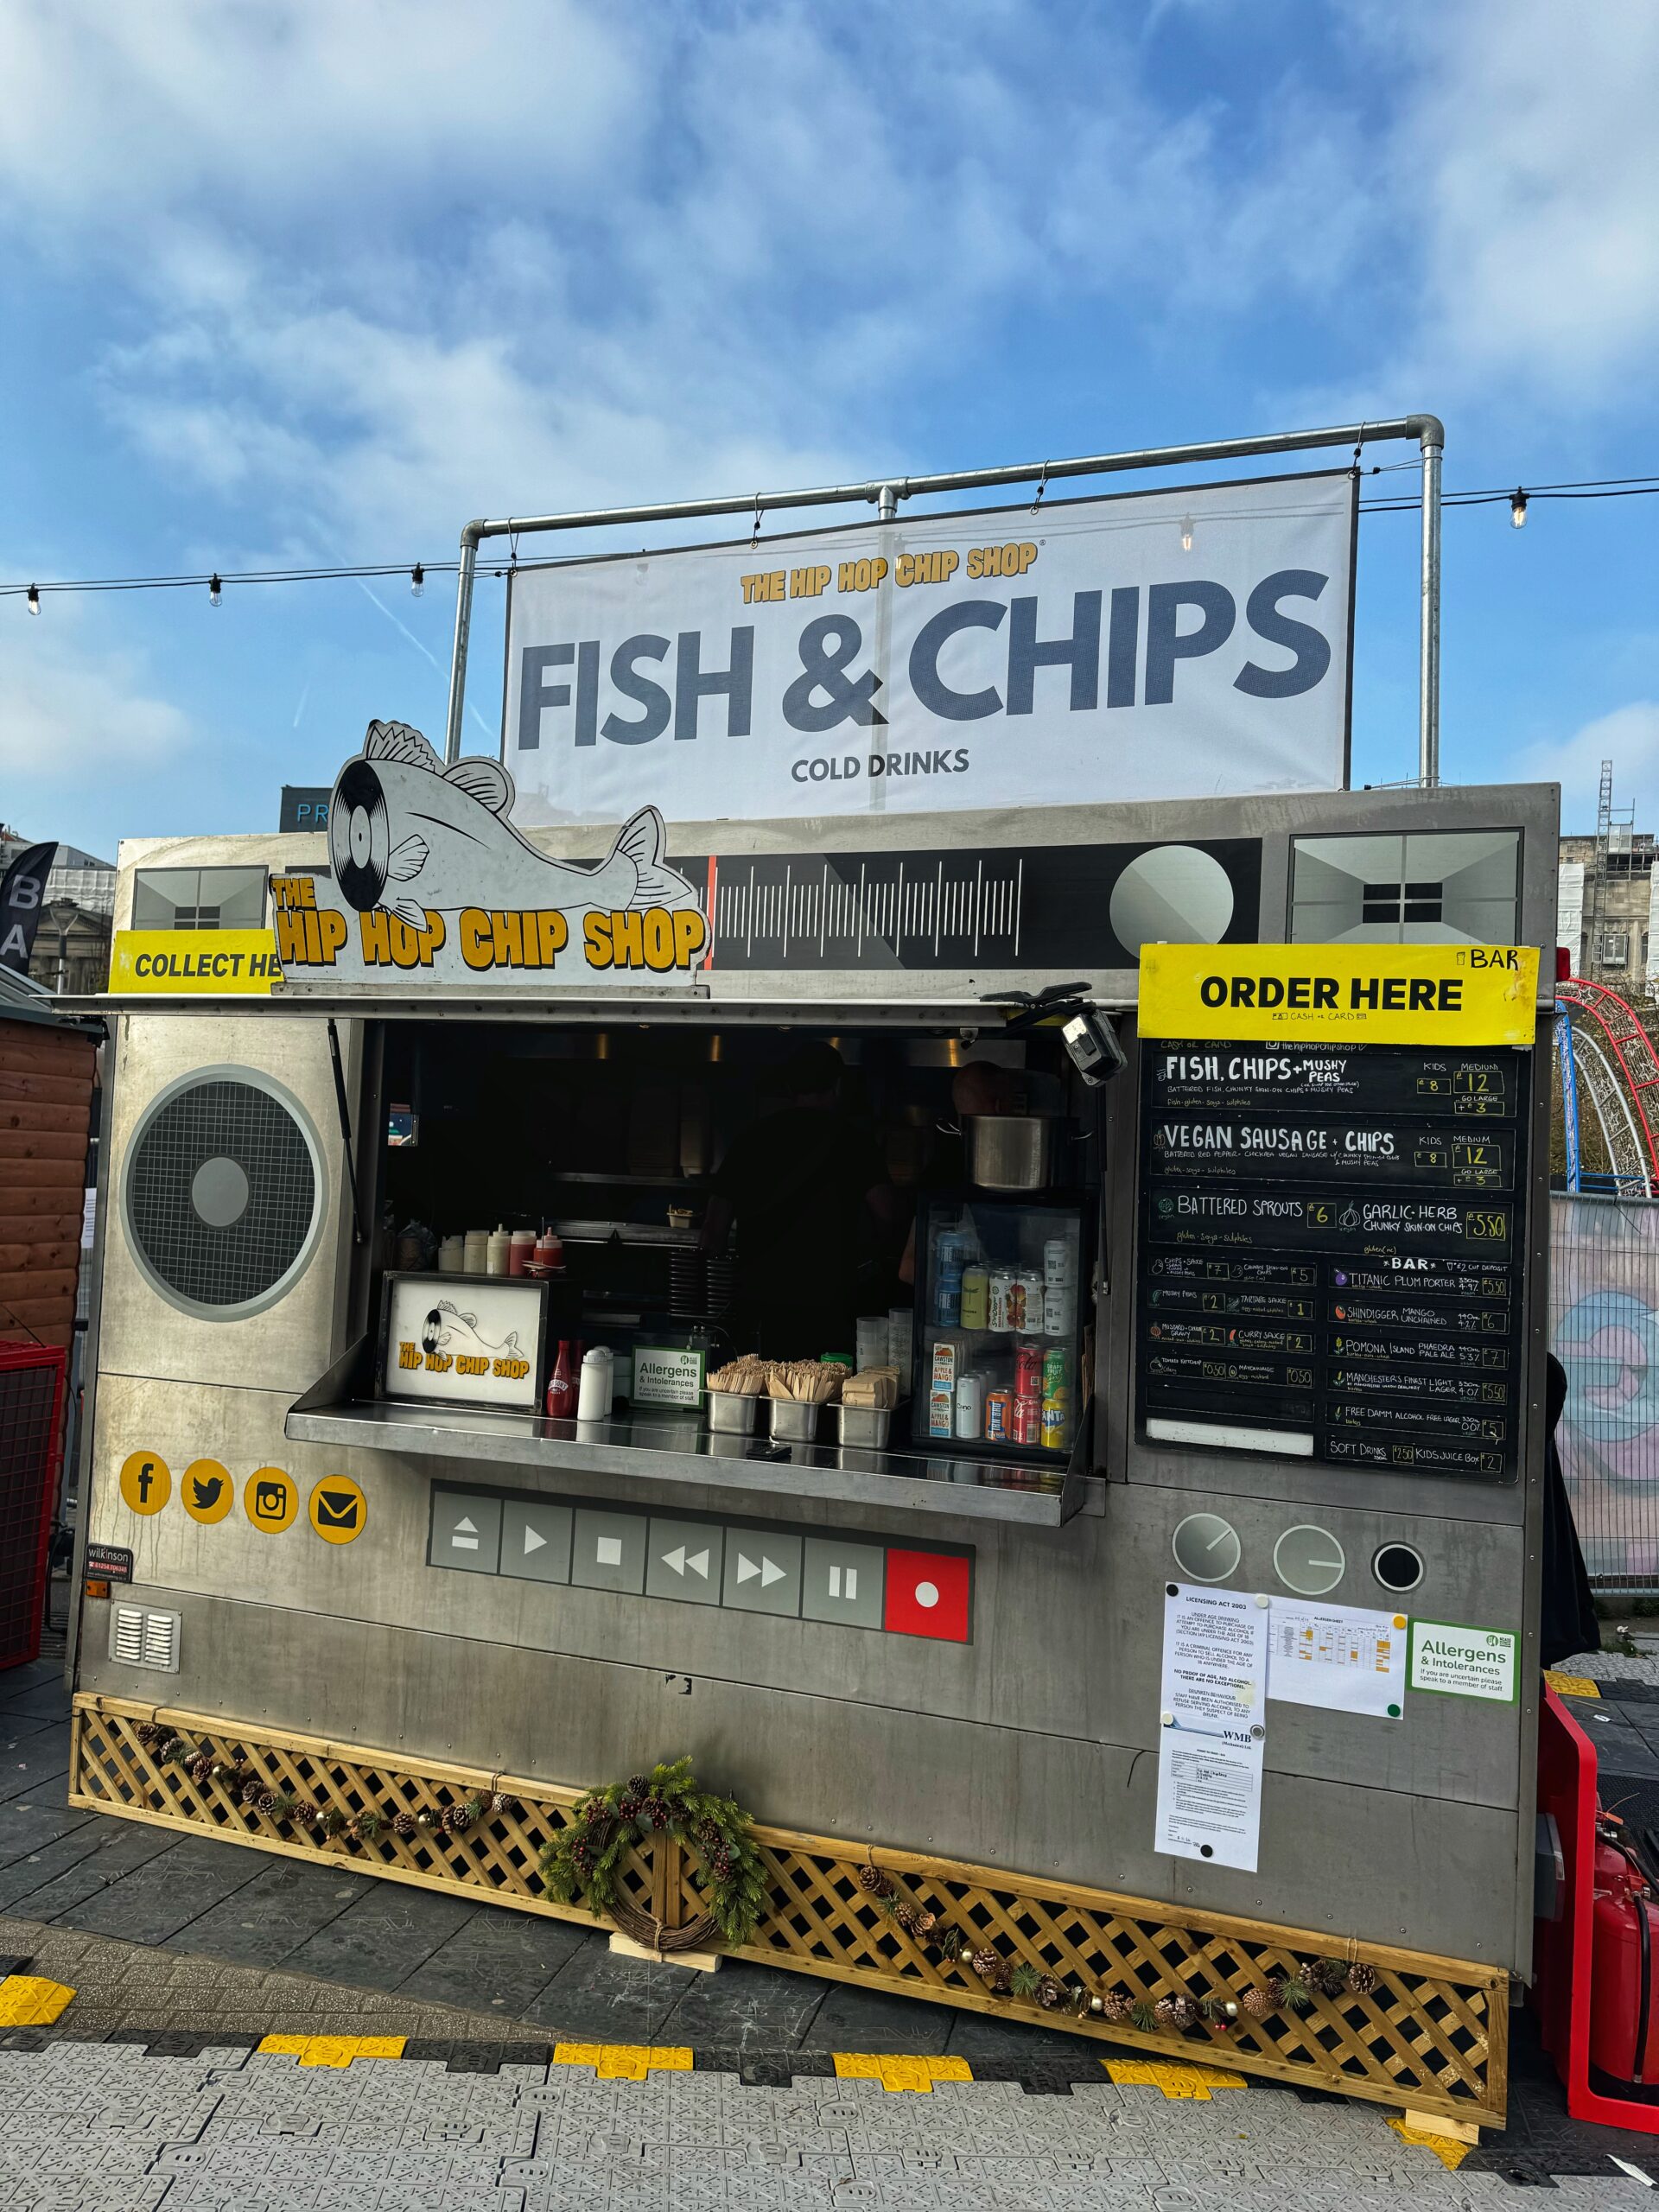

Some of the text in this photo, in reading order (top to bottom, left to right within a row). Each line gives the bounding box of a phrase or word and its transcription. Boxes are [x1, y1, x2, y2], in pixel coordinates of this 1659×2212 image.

[741, 570, 785, 604] THE
[790, 565, 831, 598] HIP
[838, 557, 888, 593] HOP
[895, 550, 959, 588] CHIP
[518, 569, 1332, 750] FISH & CHIPS
[791, 748, 969, 783] COLD DRINKS
[272, 878, 317, 911] THE
[276, 907, 706, 972] HIP HOP CHIP SHOP
[135, 953, 245, 977] COLLECT
[1471, 949, 1518, 970] BAR
[1200, 976, 1463, 1011] ORDER HERE
[1303, 1059, 1346, 1074] MUSHY
[1309, 1071, 1340, 1083] PEAS
[1164, 1124, 1232, 1149] VEGAN
[1240, 1127, 1326, 1151] SAUSAGE
[1345, 1130, 1394, 1154] CHIPS
[1419, 1136, 1442, 1145] KIDS
[1453, 1135, 1491, 1144] MEDIUM
[1178, 1195, 1303, 1217] BATTERED SPROUTS
[1363, 1220, 1401, 1231] CHUNKY
[1404, 1223, 1436, 1232] SKIN-ON
[1439, 1223, 1462, 1234] CHIPS
[1349, 1273, 1390, 1286] TITANIC
[1395, 1275, 1421, 1287] PLUM
[1423, 1277, 1456, 1288] PORTER
[1347, 1306, 1435, 1320] SHINDIGGER MANGO
[1401, 1314, 1446, 1325] UNCHAINED
[399, 1341, 416, 1352] THE
[1346, 1339, 1386, 1354] POMONA
[1418, 1342, 1455, 1351] PHAEDRA
[399, 1351, 530, 1379] HIP HOP CHIP SHOP
[639, 1363, 696, 1379] Allergens
[647, 1376, 694, 1388] Intolerances
[1404, 1376, 1427, 1386] FINEST
[1429, 1378, 1453, 1387] LIGHT
[1345, 1407, 1365, 1416] FREE
[1368, 1408, 1392, 1419] DAMM
[1395, 1412, 1425, 1421] ALCOHOL
[1330, 1440, 1387, 1457] SOFT DRINKS
[1415, 1448, 1440, 1459] KIDS
[1440, 1452, 1463, 1461] JUICE
[89, 1547, 128, 1562] wilkinson
[1185, 1596, 1217, 1605] LICENSING
[1421, 1639, 1506, 1663] Allergens
[1421, 1656, 1500, 1675] & Intolerances
[1420, 1675, 1438, 1683] speak
[1453, 1679, 1478, 1688] member
[1451, 1672, 1479, 1682] uncertain
[1481, 1677, 1502, 1686] please
[1224, 1730, 1252, 1743] WMB
